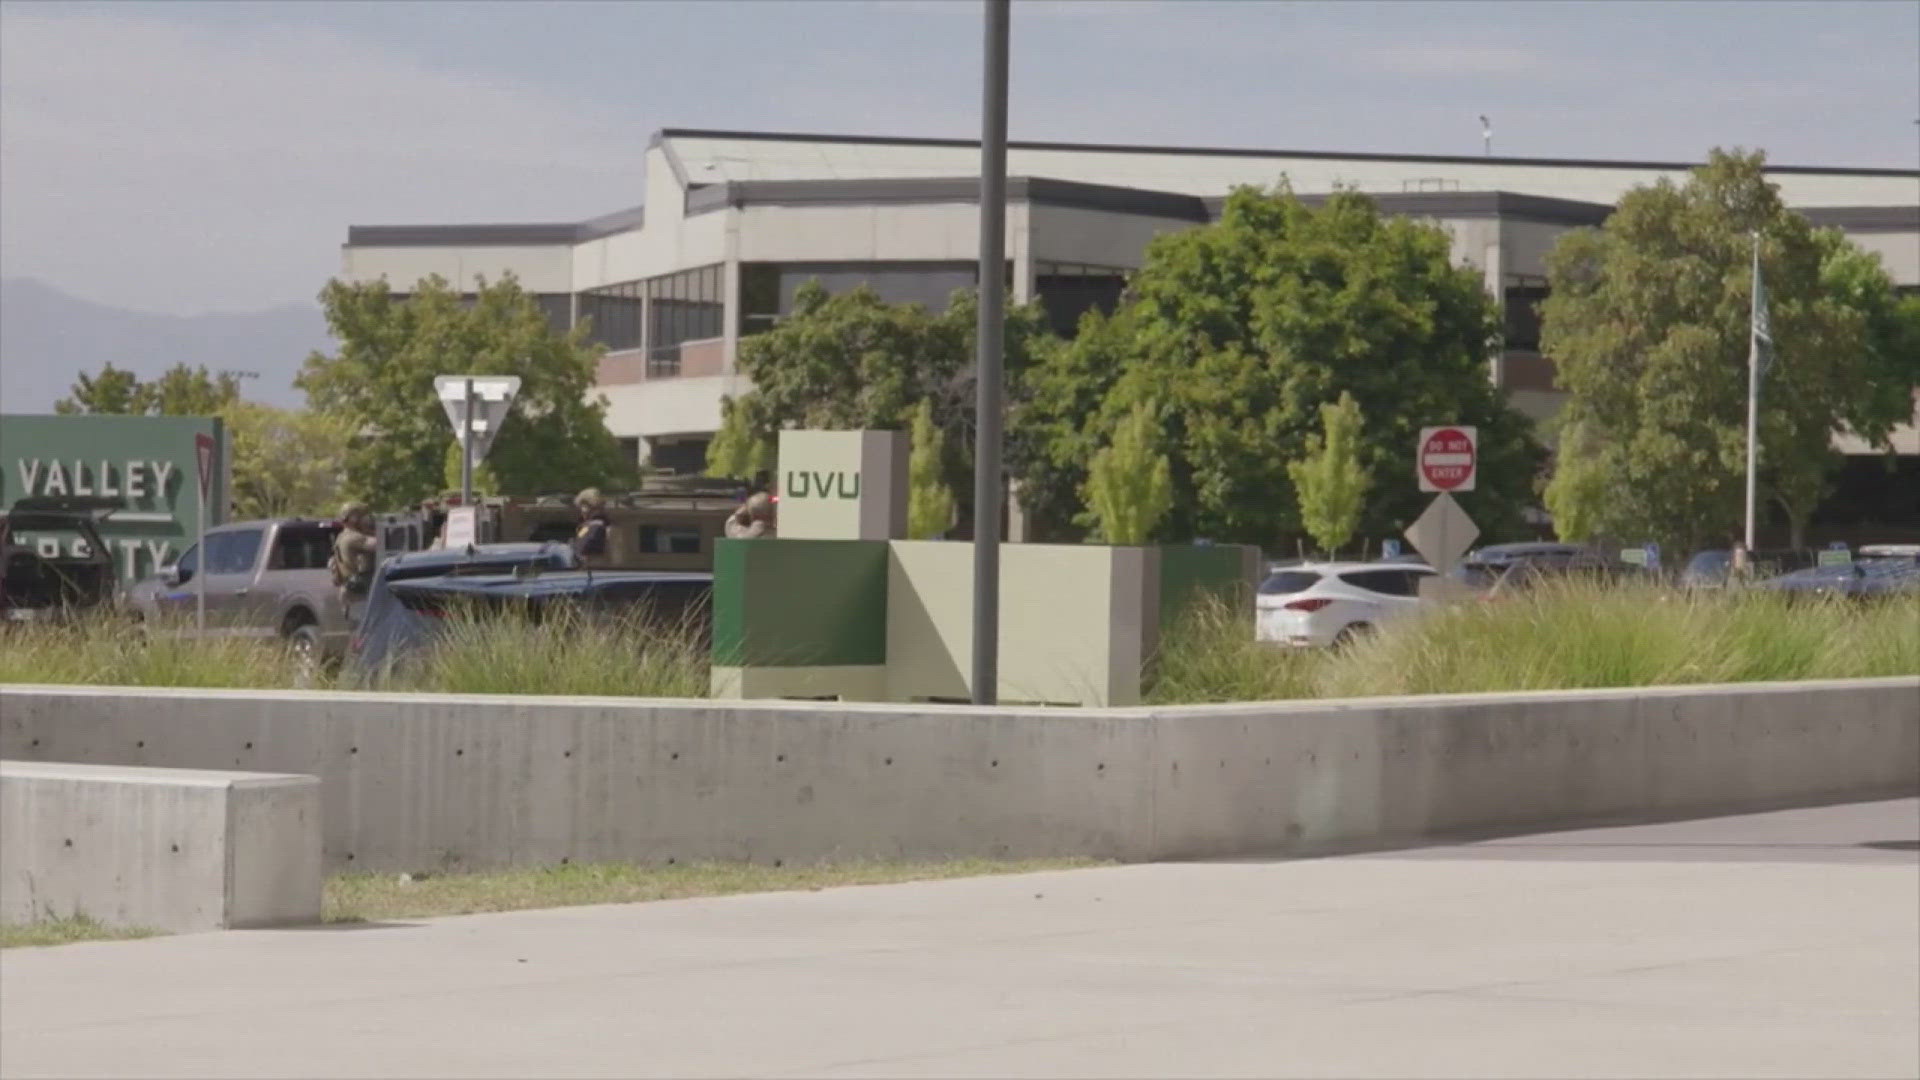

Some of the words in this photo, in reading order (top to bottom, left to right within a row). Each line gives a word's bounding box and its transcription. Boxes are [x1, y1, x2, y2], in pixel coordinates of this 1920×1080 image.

[1428, 440, 1444, 451] DO
[1448, 440, 1467, 451] NOT
[18, 458, 172, 497] VALLEY
[1432, 467, 1463, 478] ENTER
[787, 471, 859, 499] UVU
